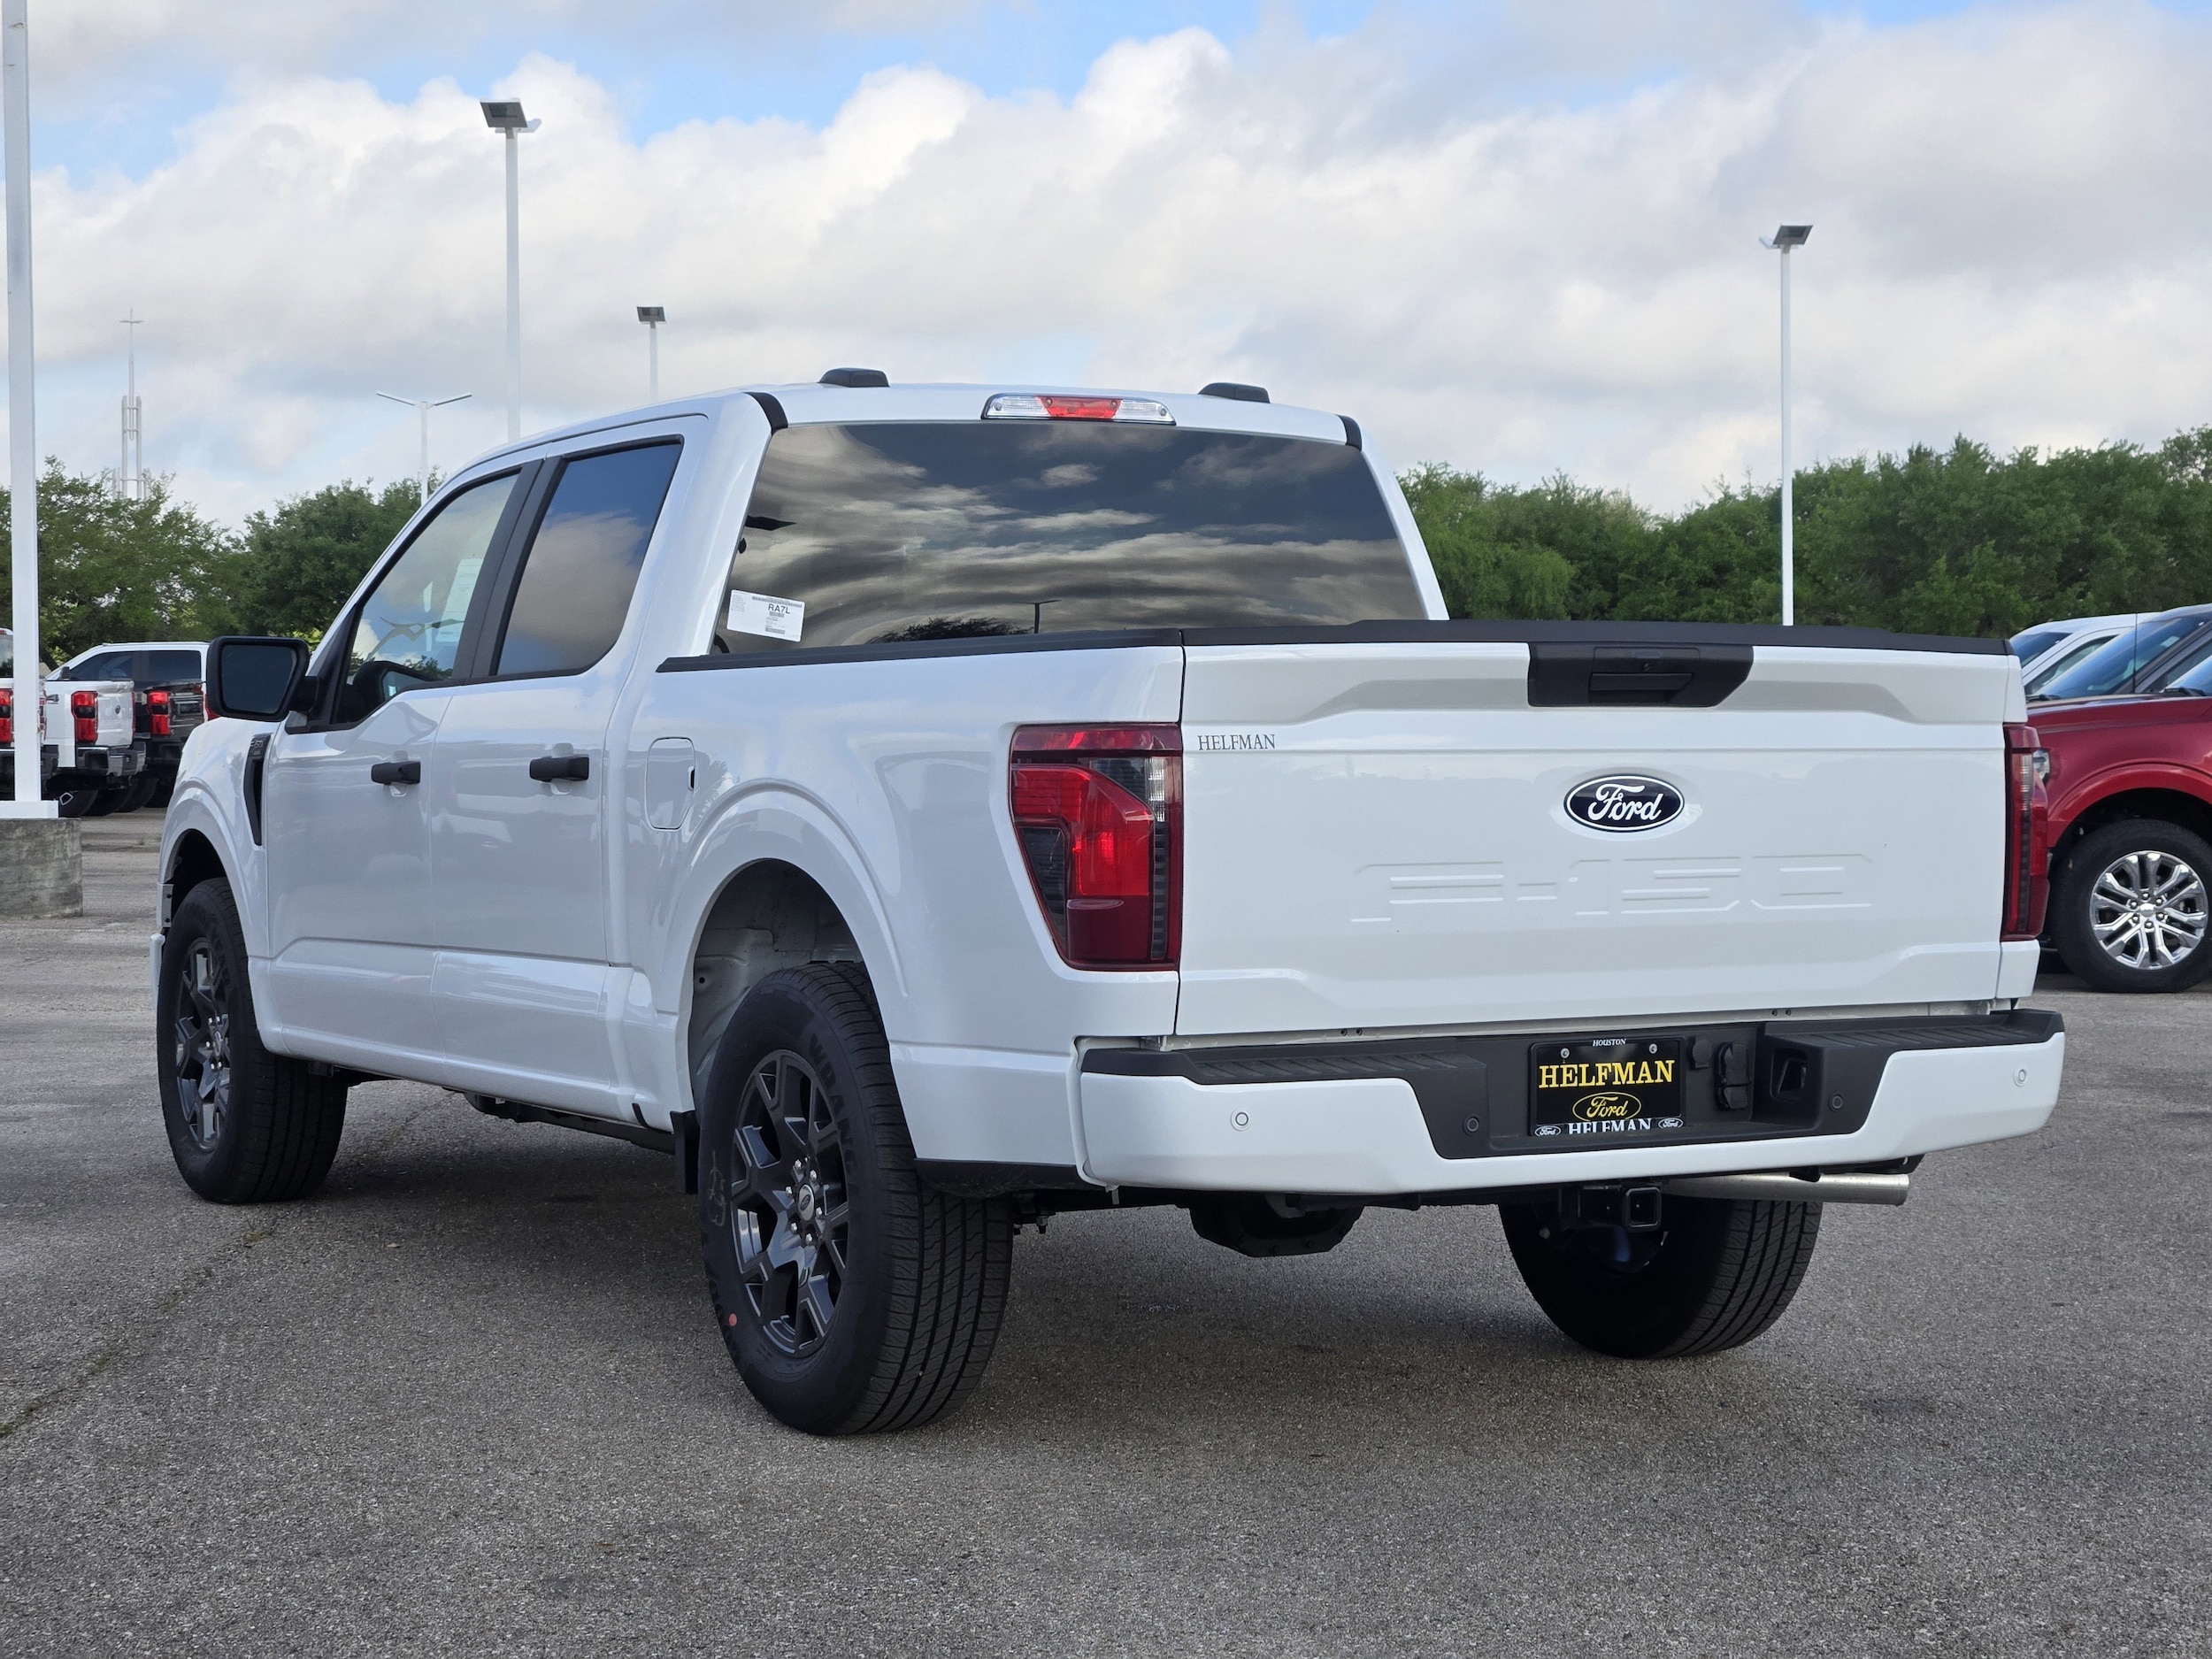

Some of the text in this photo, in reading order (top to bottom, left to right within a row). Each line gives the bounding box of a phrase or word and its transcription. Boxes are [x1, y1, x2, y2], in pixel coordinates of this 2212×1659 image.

[767, 603, 791, 614] RA7L
[1197, 733, 1276, 751] HELFMAN
[1587, 783, 1664, 821] Ford
[1592, 1038, 1627, 1047] HOUSTON
[1538, 1060, 1676, 1088] HELFMAN
[1586, 1096, 1629, 1118] Ford
[1568, 1118, 1653, 1135] HELFMAN
